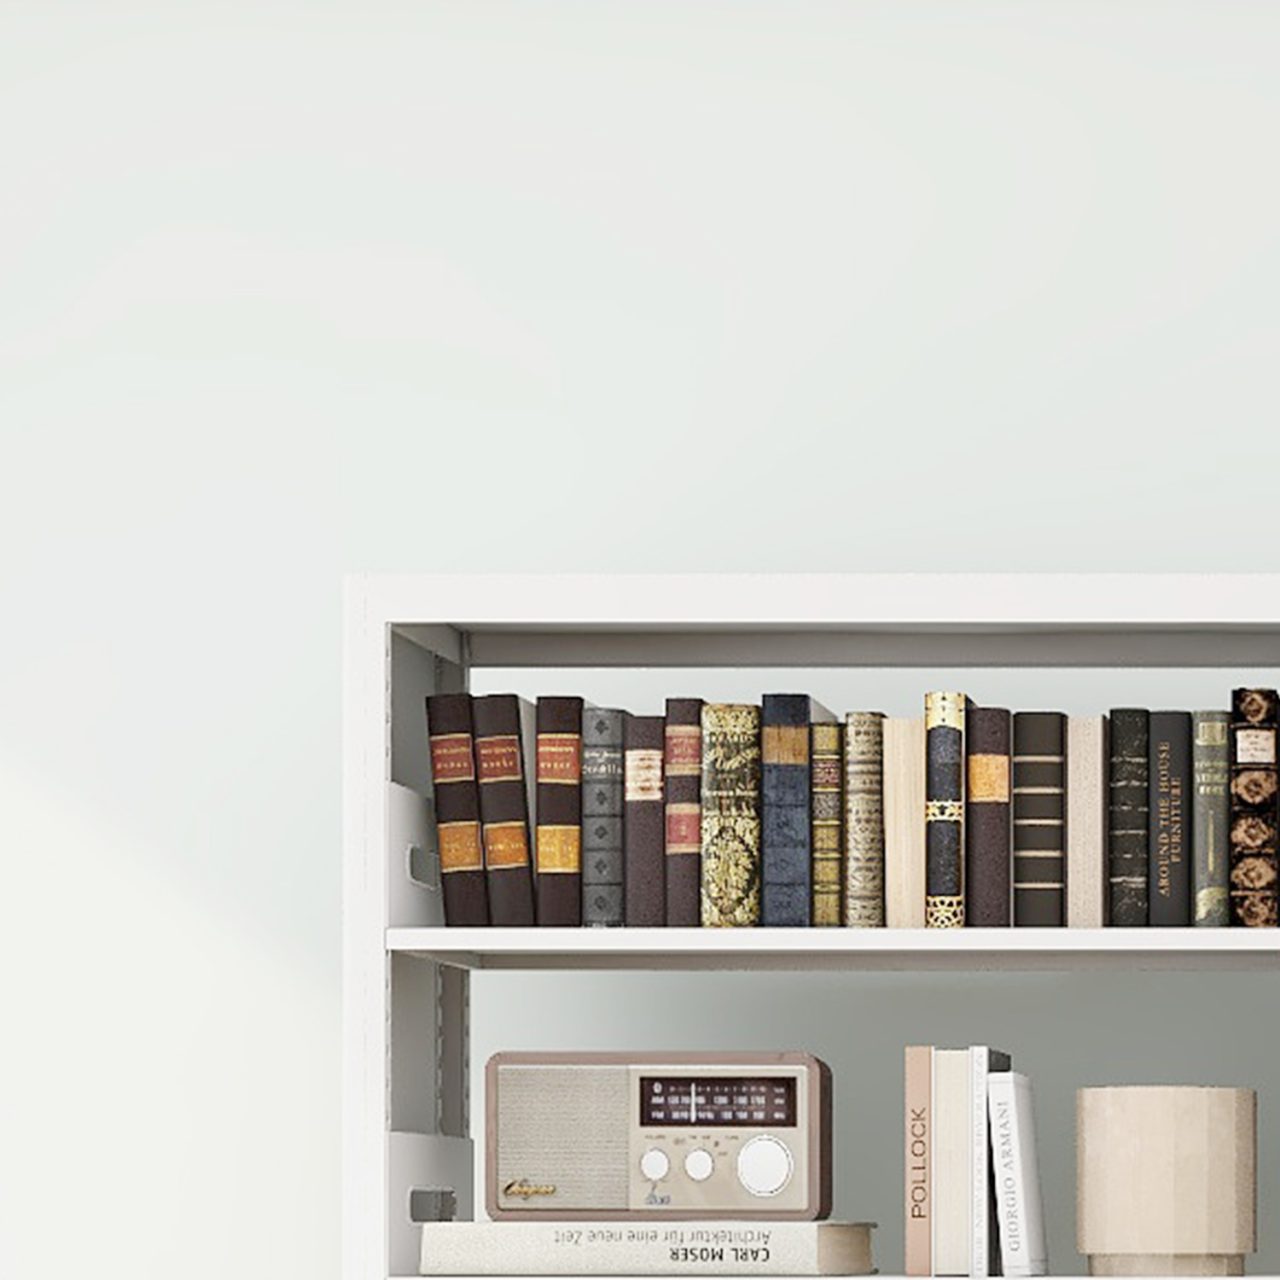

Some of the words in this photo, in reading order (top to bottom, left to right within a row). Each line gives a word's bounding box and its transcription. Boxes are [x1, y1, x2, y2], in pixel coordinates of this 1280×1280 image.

[1158, 741, 1170, 793] HOUSE
[1158, 797, 1170, 829] THE
[1171, 777, 1182, 863] FURNITURE
[1158, 832, 1170, 897] AROUND
[998, 1101, 1014, 1172] ARMANI
[911, 1107, 927, 1219] POLLOCK
[1003, 1177, 1021, 1252] GIORGIO
[554, 1230, 583, 1245] Zeit
[587, 1230, 623, 1245] neue
[627, 1230, 660, 1245] eine
[663, 1230, 685, 1245] für
[689, 1230, 771, 1245] Architektur
[669, 1247, 724, 1262] MOSER
[731, 1247, 771, 1262] CARL
